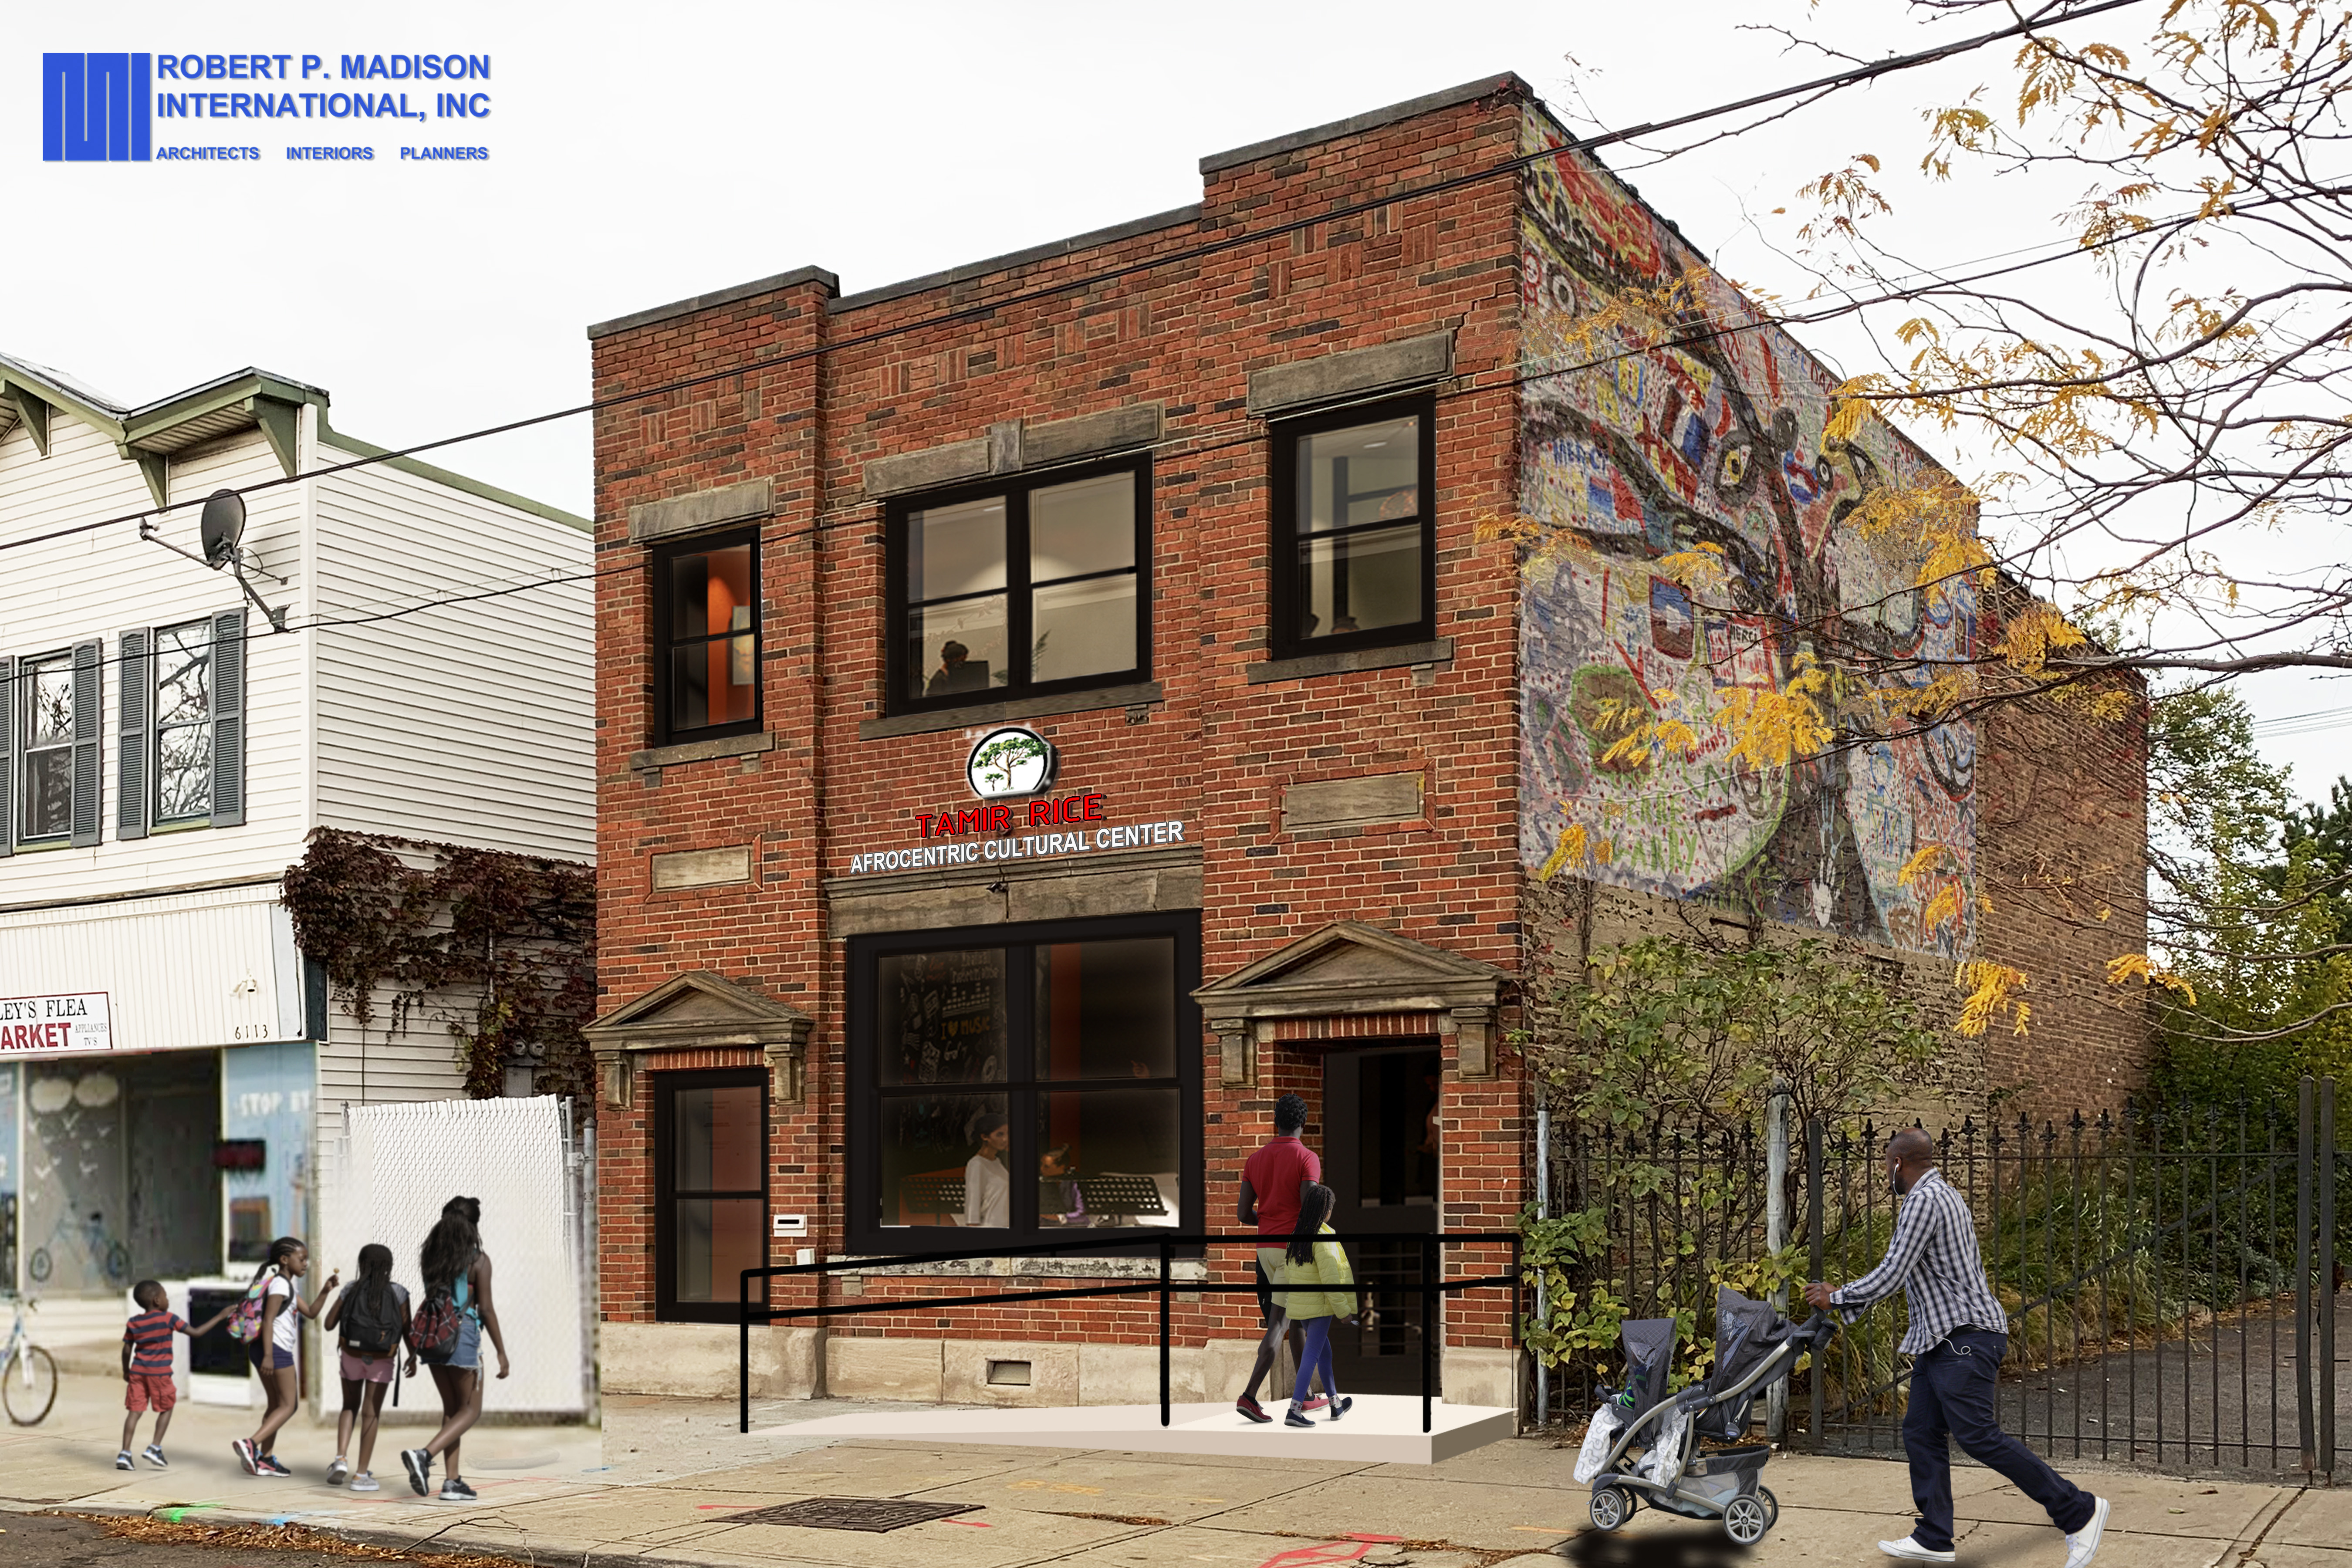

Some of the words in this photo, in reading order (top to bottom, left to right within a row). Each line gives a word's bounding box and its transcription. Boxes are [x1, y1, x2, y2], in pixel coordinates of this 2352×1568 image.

[915, 805, 1011, 838] TAMIR
[1030, 793, 1105, 827] RICE
[850, 841, 980, 873] AFROCENTRIC
[983, 830, 1090, 859] CULTURAL
[1095, 820, 1185, 848] CENTER
[46, 998, 88, 1017] FLEA
[235, 1024, 268, 1040] 6113
